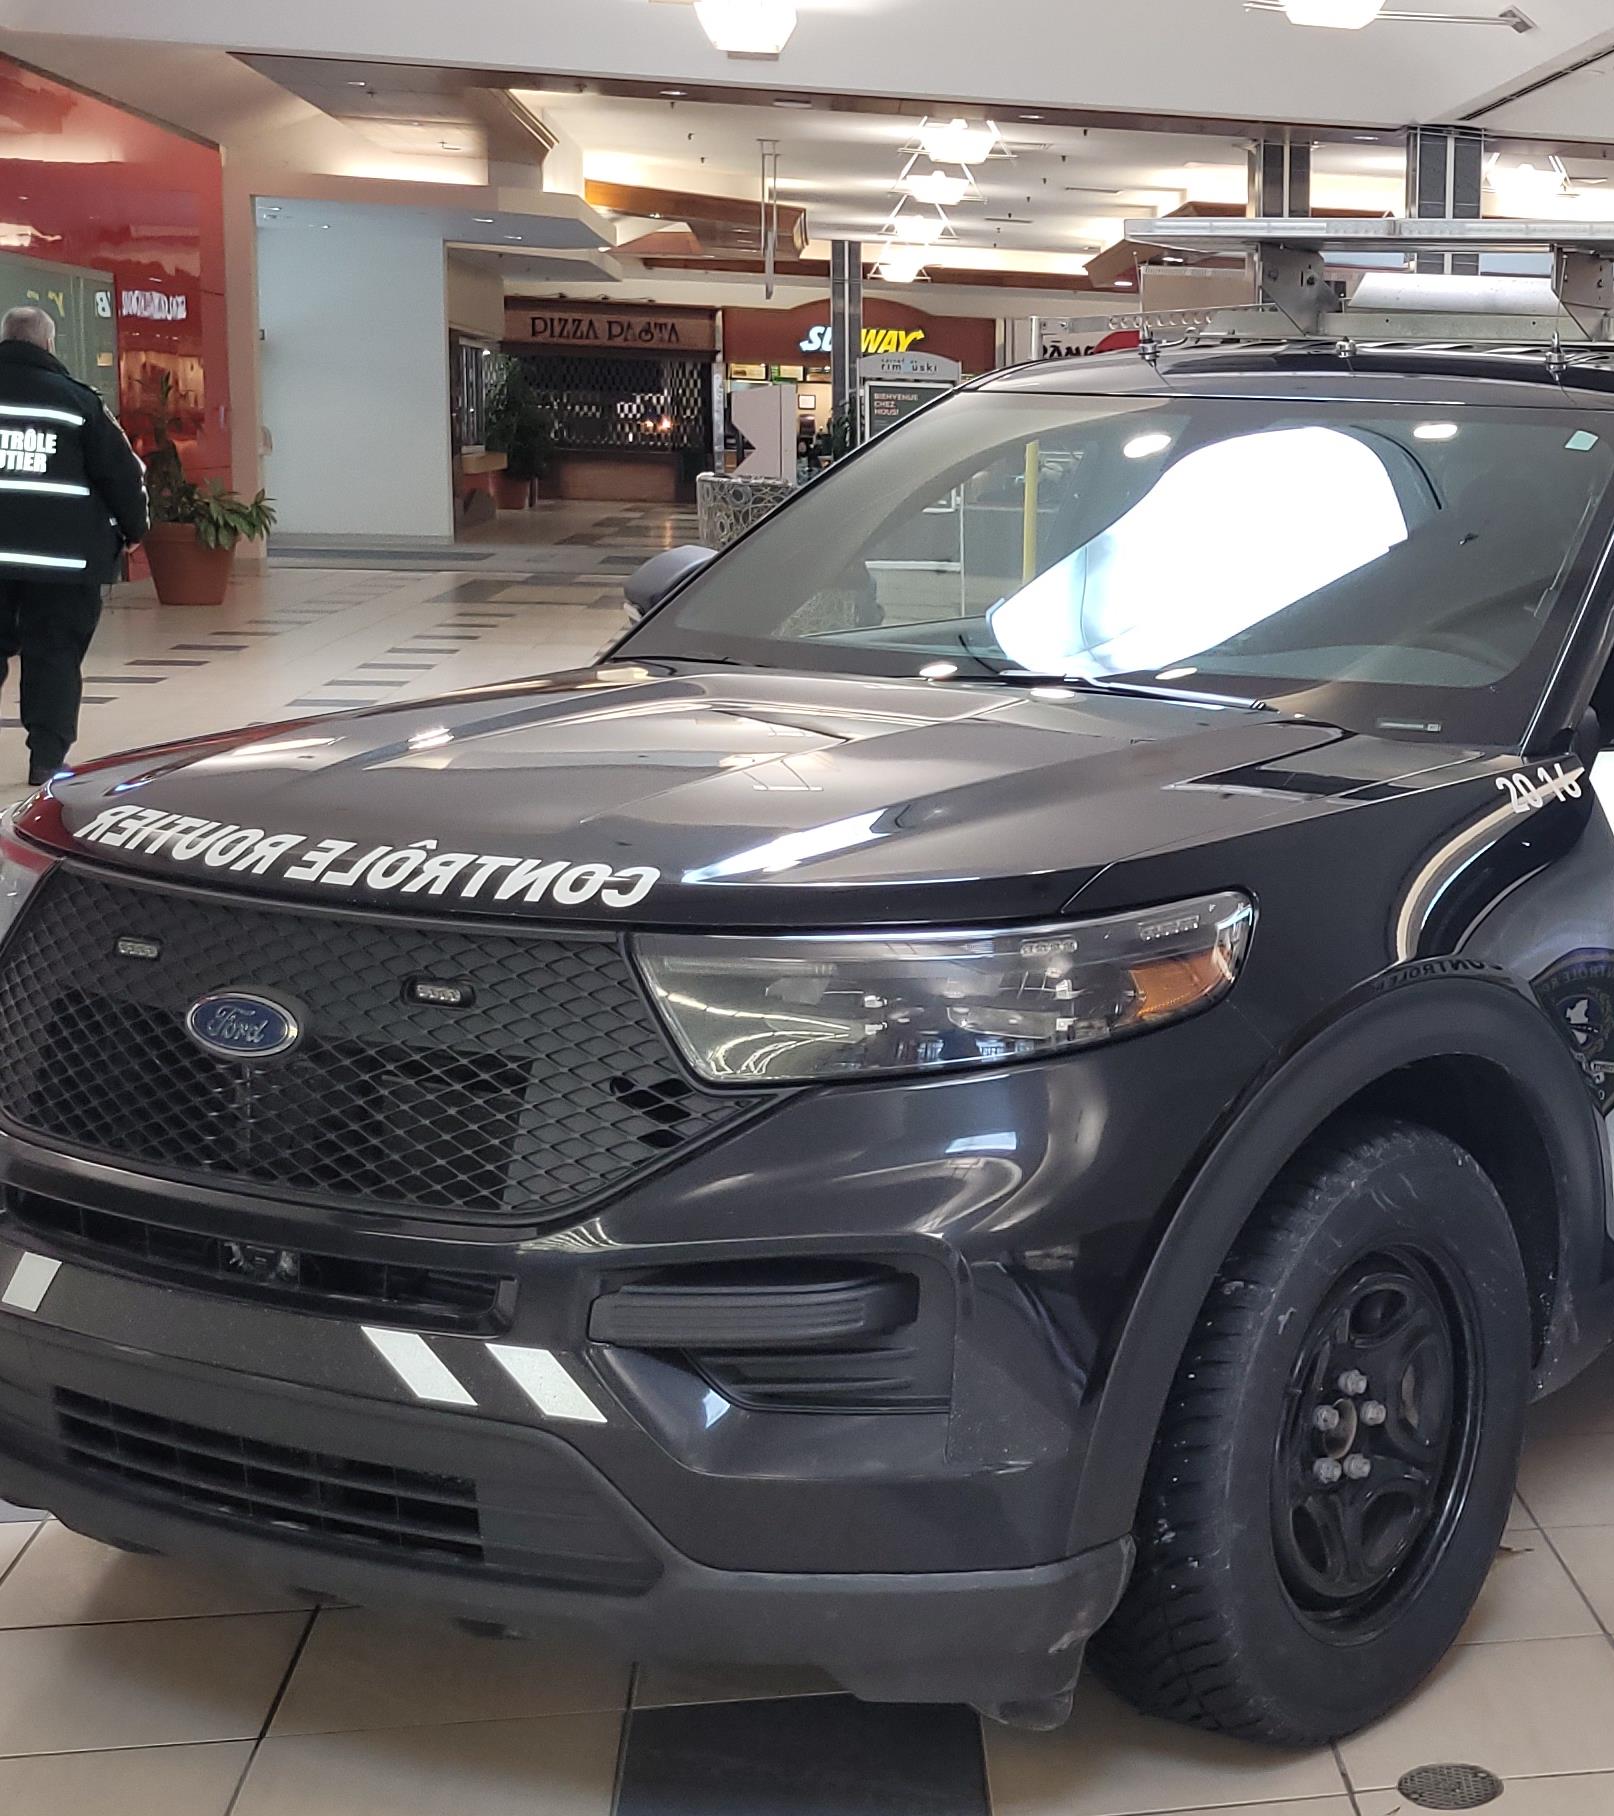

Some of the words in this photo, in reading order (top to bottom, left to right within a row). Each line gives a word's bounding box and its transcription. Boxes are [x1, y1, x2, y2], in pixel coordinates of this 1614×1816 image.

[530, 317, 599, 339] PIZZA
[606, 320, 680, 343] PASTA
[800, 326, 925, 353] SWAY
[881, 361, 937, 373] rimuski
[207, 1006, 268, 1043] Ford
